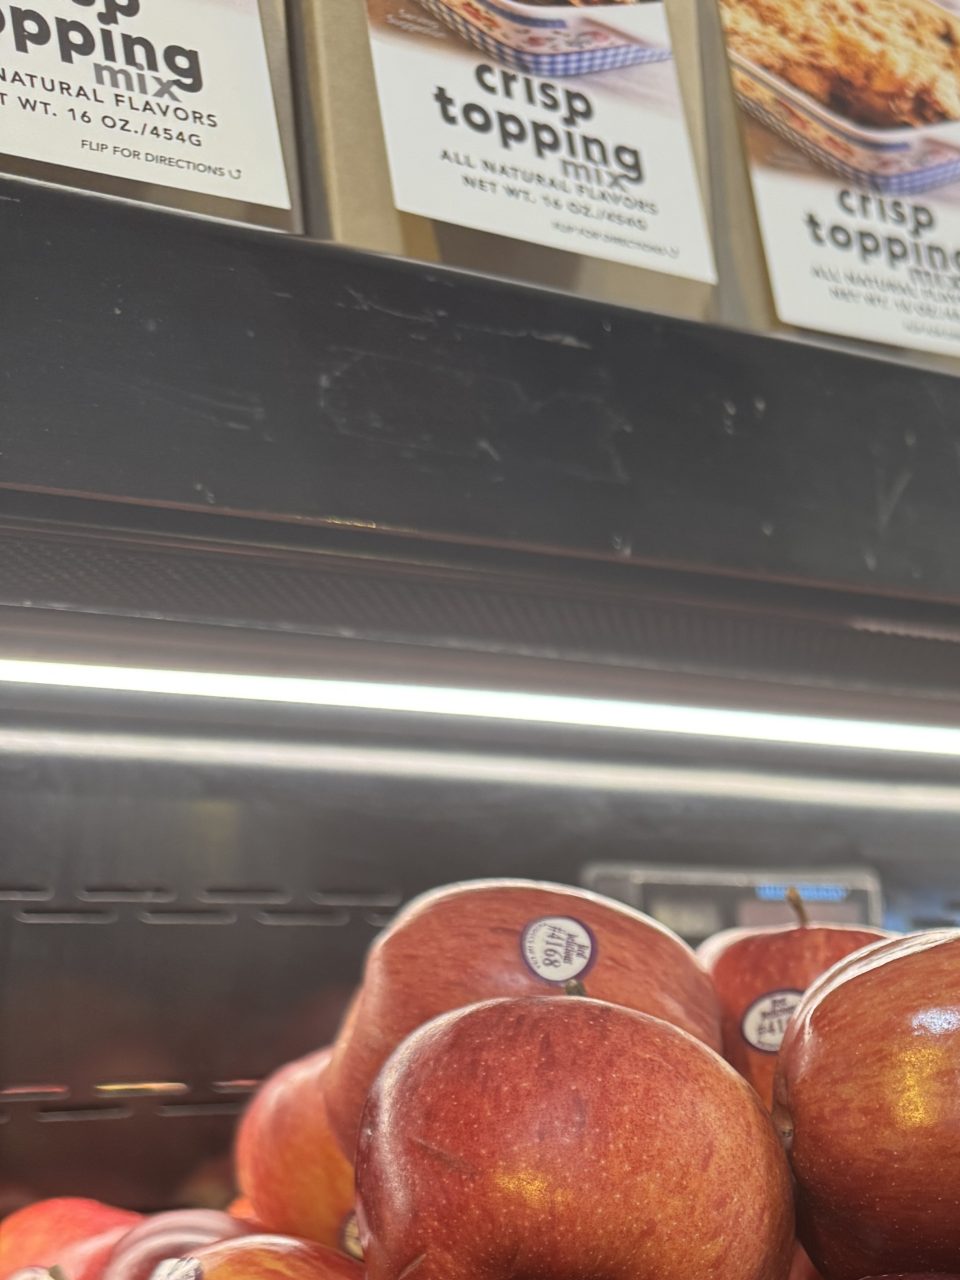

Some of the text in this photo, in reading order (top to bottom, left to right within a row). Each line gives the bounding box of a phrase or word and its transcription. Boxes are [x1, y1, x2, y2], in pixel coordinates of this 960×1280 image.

[0, 5, 203, 93] pping
[93, 62, 182, 102] mix
[474, 63, 594, 126] crisp
[17, 95, 57, 117] WT.
[67, 107, 92, 124] 16
[101, 115, 203, 147] OZ./454G
[114, 93, 218, 127] FLAVORS
[433, 85, 646, 184] topping
[80, 139, 225, 177] FLIP FOR DIRECTIONS
[440, 149, 476, 169] ALL
[481, 159, 572, 193] NATURAL
[560, 159, 627, 193] mix
[837, 181, 934, 237] crisp
[542, 923, 568, 969] #4168
[757, 1019, 784, 1037] #41
